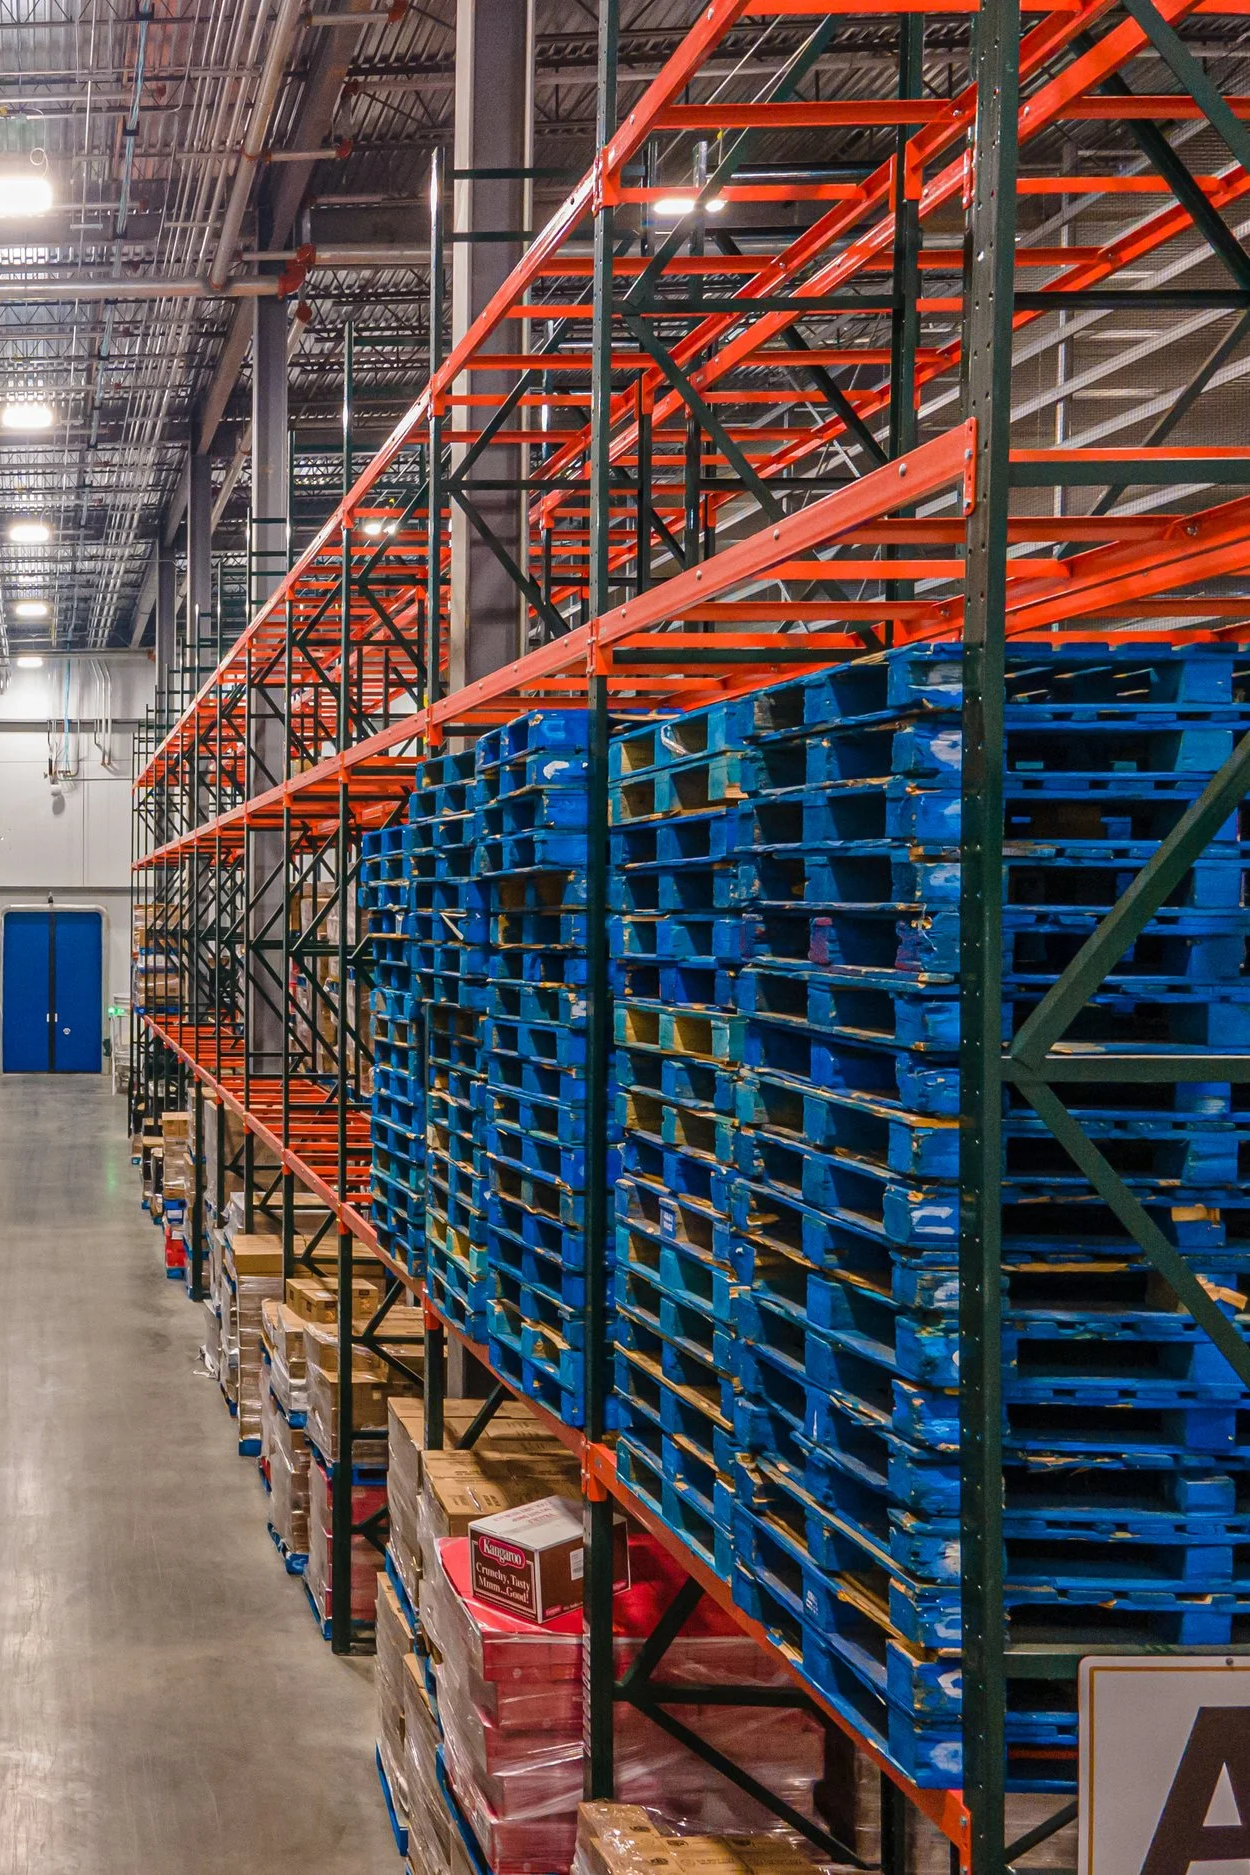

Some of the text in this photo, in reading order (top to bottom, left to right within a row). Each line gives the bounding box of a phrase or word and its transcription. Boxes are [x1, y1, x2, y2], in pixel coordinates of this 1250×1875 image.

[483, 1538, 522, 1565] Kangaroo
[476, 1562, 530, 1590] Crunchy, Tasty
[1140, 1706, 1250, 1875] A
